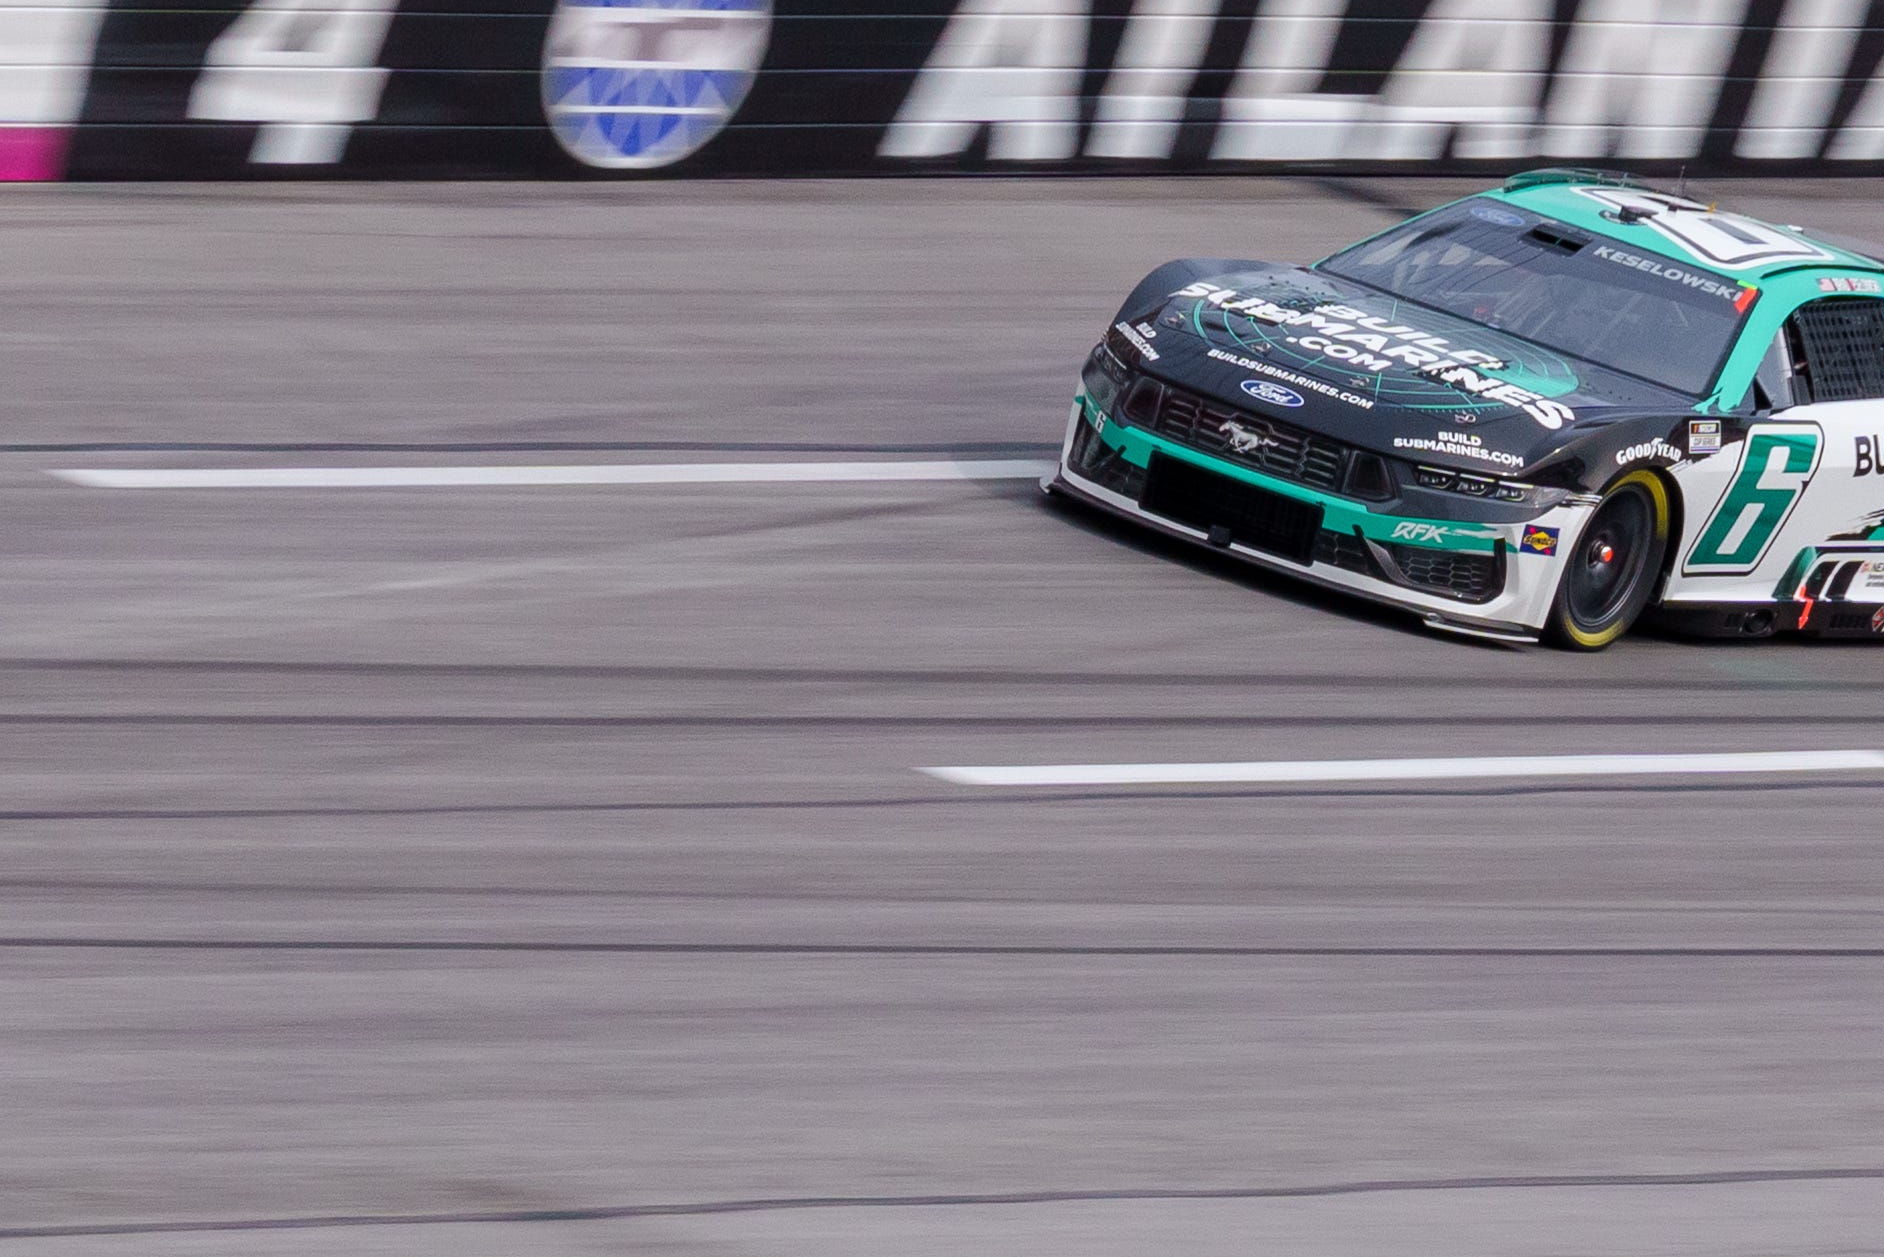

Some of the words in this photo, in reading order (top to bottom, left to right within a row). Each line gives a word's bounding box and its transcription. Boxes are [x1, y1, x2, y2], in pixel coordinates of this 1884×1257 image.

[1593, 245, 1743, 301] KESELOWSKI
[1286, 334, 1393, 372] .COM
[1207, 348, 1375, 410] BUILDSUBMARINES.COM
[1245, 380, 1299, 405] Ford
[1393, 437, 1524, 467] SUBMARINES.COM
[1438, 431, 1482, 446] BUILD
[1615, 437, 1682, 465] GOODYEAR
[1681, 425, 1822, 575] 6
